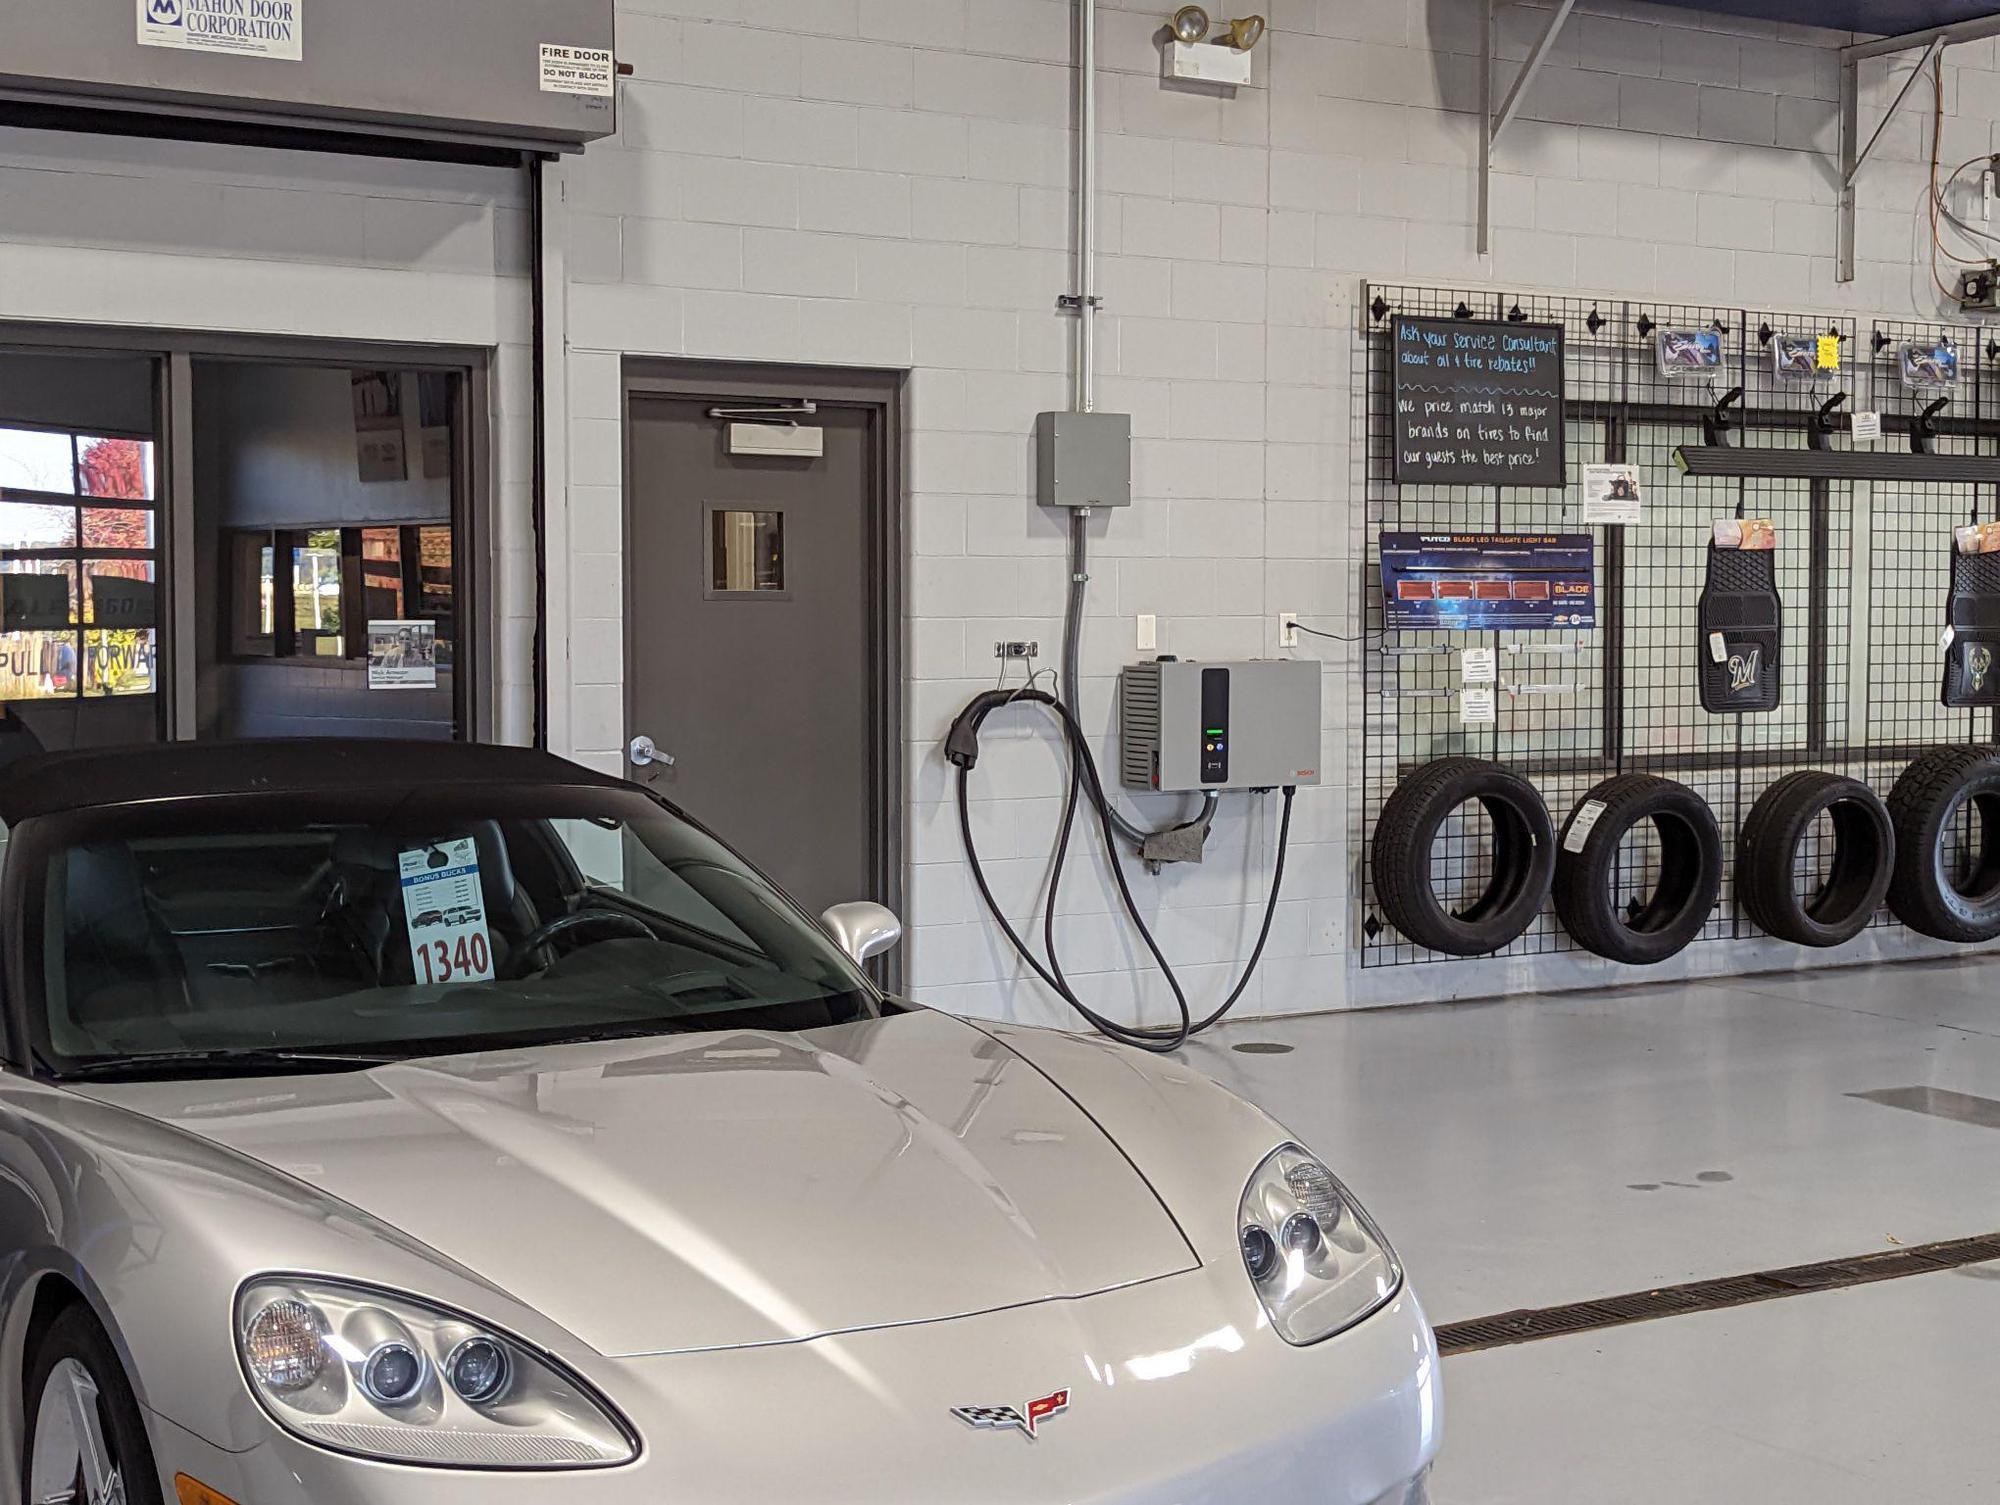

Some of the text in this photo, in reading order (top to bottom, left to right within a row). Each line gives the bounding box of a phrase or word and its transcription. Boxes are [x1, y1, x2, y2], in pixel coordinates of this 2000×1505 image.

[186, 0, 293, 22] MAHON DOOR
[187, 12, 292, 41] CORPORATION
[542, 47, 609, 62] FIRE DOOR
[543, 68, 609, 81] DO NOT BLOCK
[1400, 323, 1558, 356] Ask your Service Consultant
[1401, 351, 1430, 366] about
[1464, 352, 1484, 370] tire
[1488, 354, 1536, 374] rebates!!
[1398, 400, 1548, 420] We price match 13 major
[1407, 420, 1550, 442] brands on tires to find
[1424, 449, 1456, 470] guests
[1460, 449, 1479, 463] the
[1483, 449, 1505, 466] best
[1507, 447, 1540, 471] price!
[1491, 536, 1522, 544] TAILGATE
[1554, 585, 1590, 594] BLADE
[0, 642, 50, 677] PULL
[413, 867, 467, 884] BONUS BUCKS
[416, 932, 489, 984] 1340
